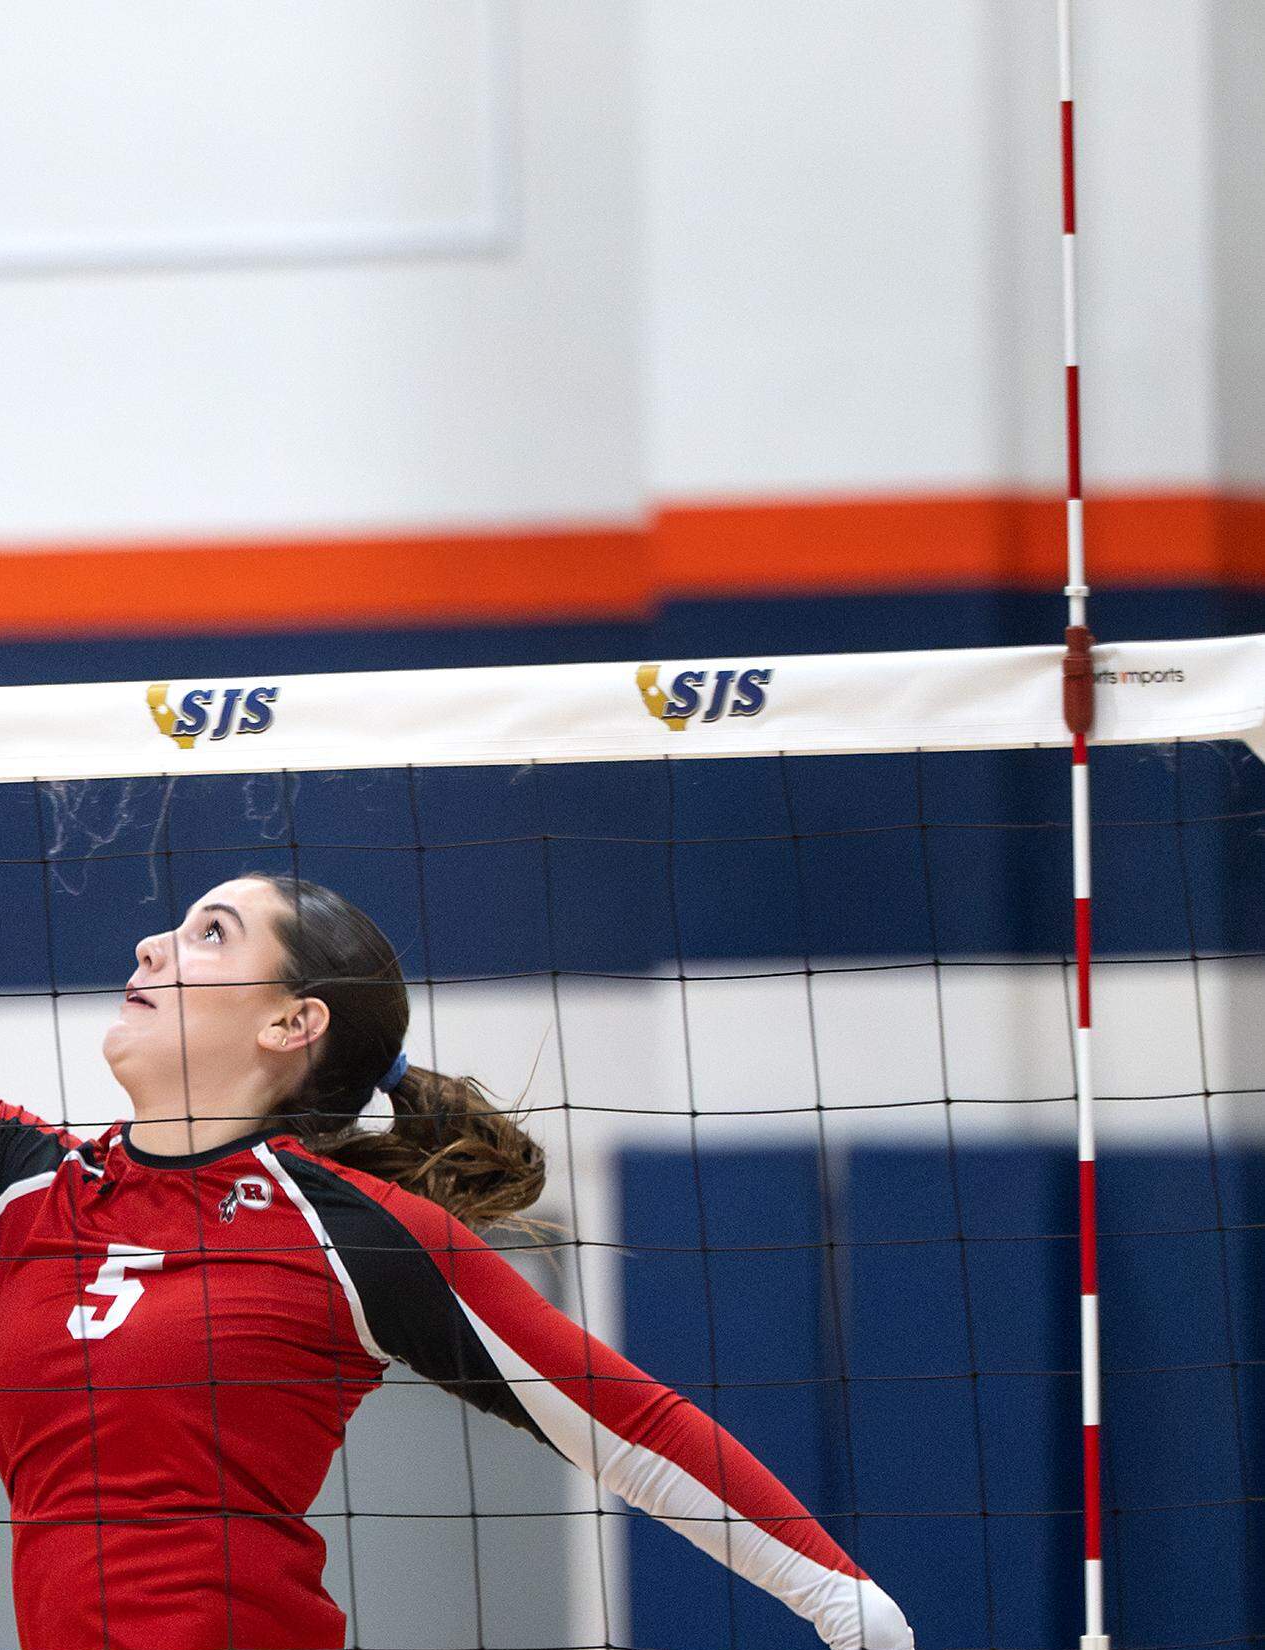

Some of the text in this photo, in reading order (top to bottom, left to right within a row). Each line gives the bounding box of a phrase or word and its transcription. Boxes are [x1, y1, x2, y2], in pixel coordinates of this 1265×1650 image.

[172, 686, 280, 741] SJS
[661, 668, 775, 723] SJS
[240, 1182, 267, 1202] R
[65, 1242, 166, 1340] 5
